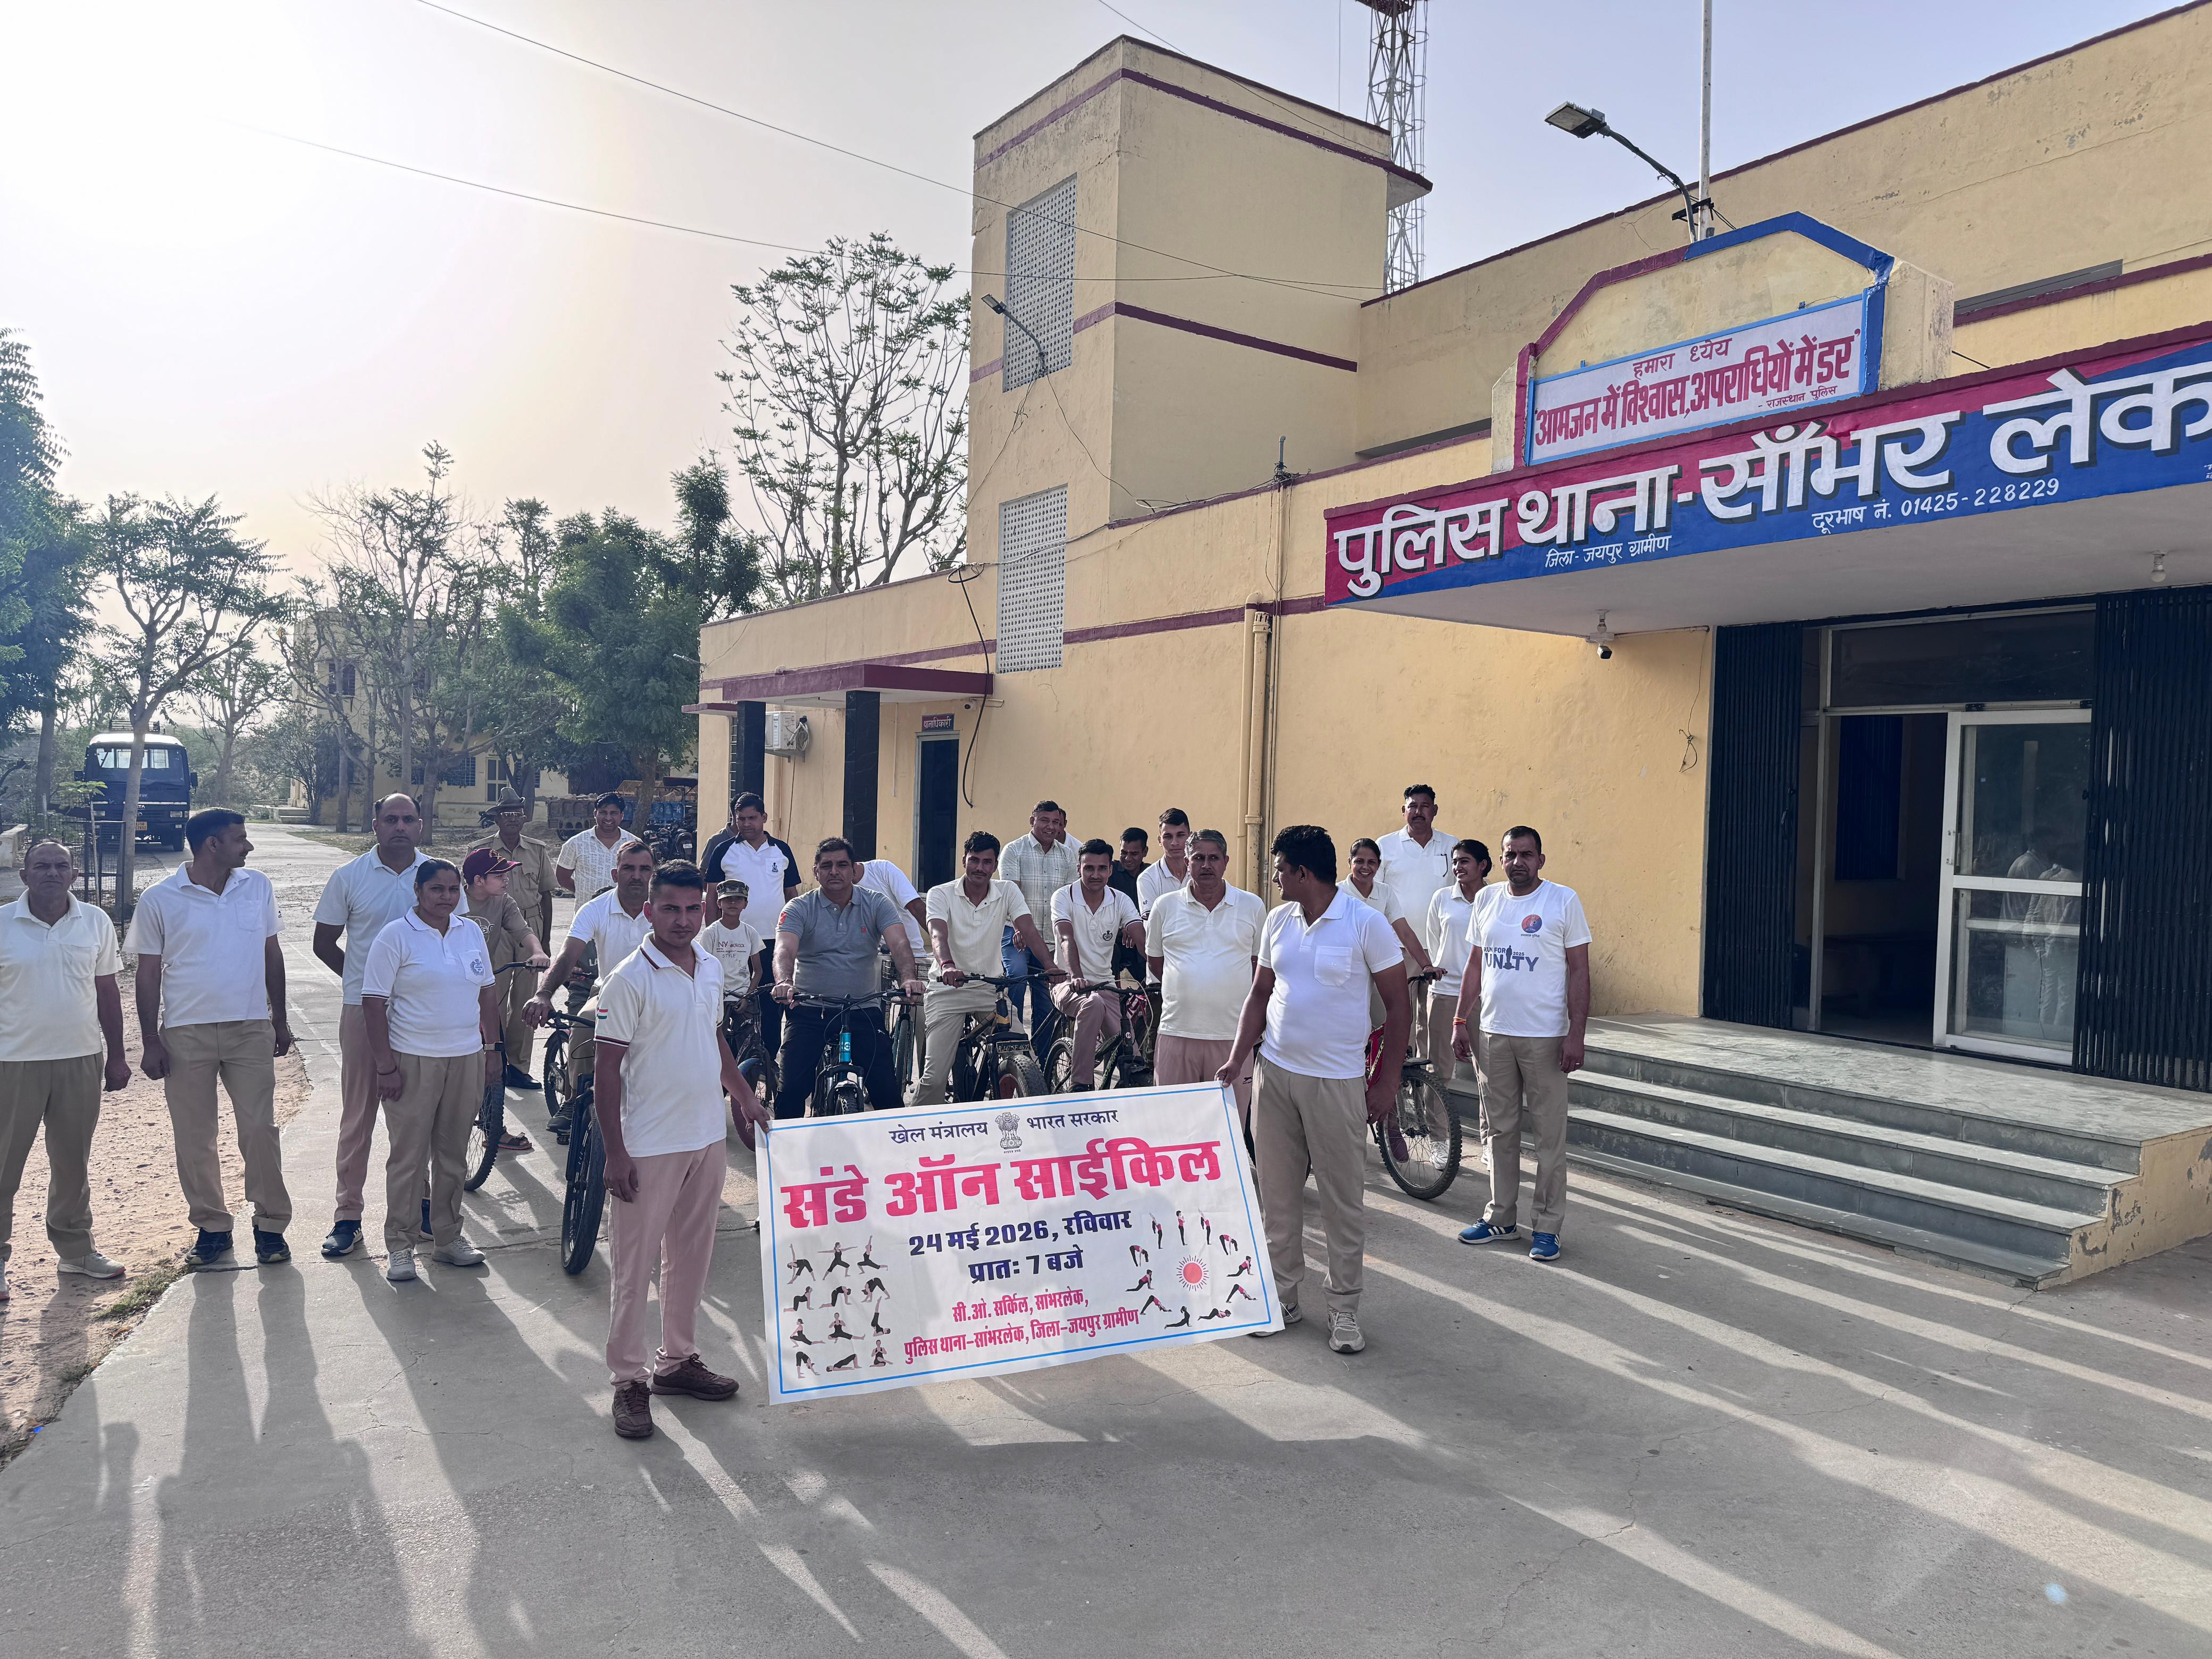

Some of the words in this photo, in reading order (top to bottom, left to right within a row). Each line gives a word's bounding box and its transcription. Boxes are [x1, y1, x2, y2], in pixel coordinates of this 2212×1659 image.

[1633, 353, 1675, 380] हमारा
[1690, 338, 1732, 362] ध्येय
[1766, 392, 1805, 409] राजस्थान
[1812, 386, 1837, 402] पुलिस
[1812, 506, 1866, 534] दूरभाष
[1901, 478, 2059, 516] 01425-228229
[1334, 498, 1509, 596] पुलिस
[1583, 543, 1622, 565] जयपुर
[1628, 533, 1672, 557] ग्रामीण
[889, 1124, 925, 1144] खेल
[928, 1121, 988, 1139] मंत्रालय
[1027, 1115, 1065, 1129] भारत
[1068, 1110, 1119, 1127] सरकार
[781, 1164, 869, 1229] संडे
[885, 1154, 1001, 1217] ऑन
[1012, 1137, 1221, 1201] साईकिल
[909, 1233, 942, 1256] 24
[946, 1222, 980, 1251] मई
[985, 1220, 1058, 1246] 2026,
[1062, 1210, 1132, 1235] रविवार
[1026, 1255, 1040, 1275] 7
[1045, 1244, 1084, 1271] बजे
[1036, 1286, 1089, 1311] सांभरलेक,
[904, 1336, 938, 1364] पुलिस
[1103, 1306, 1139, 1329] ग्रामीण
